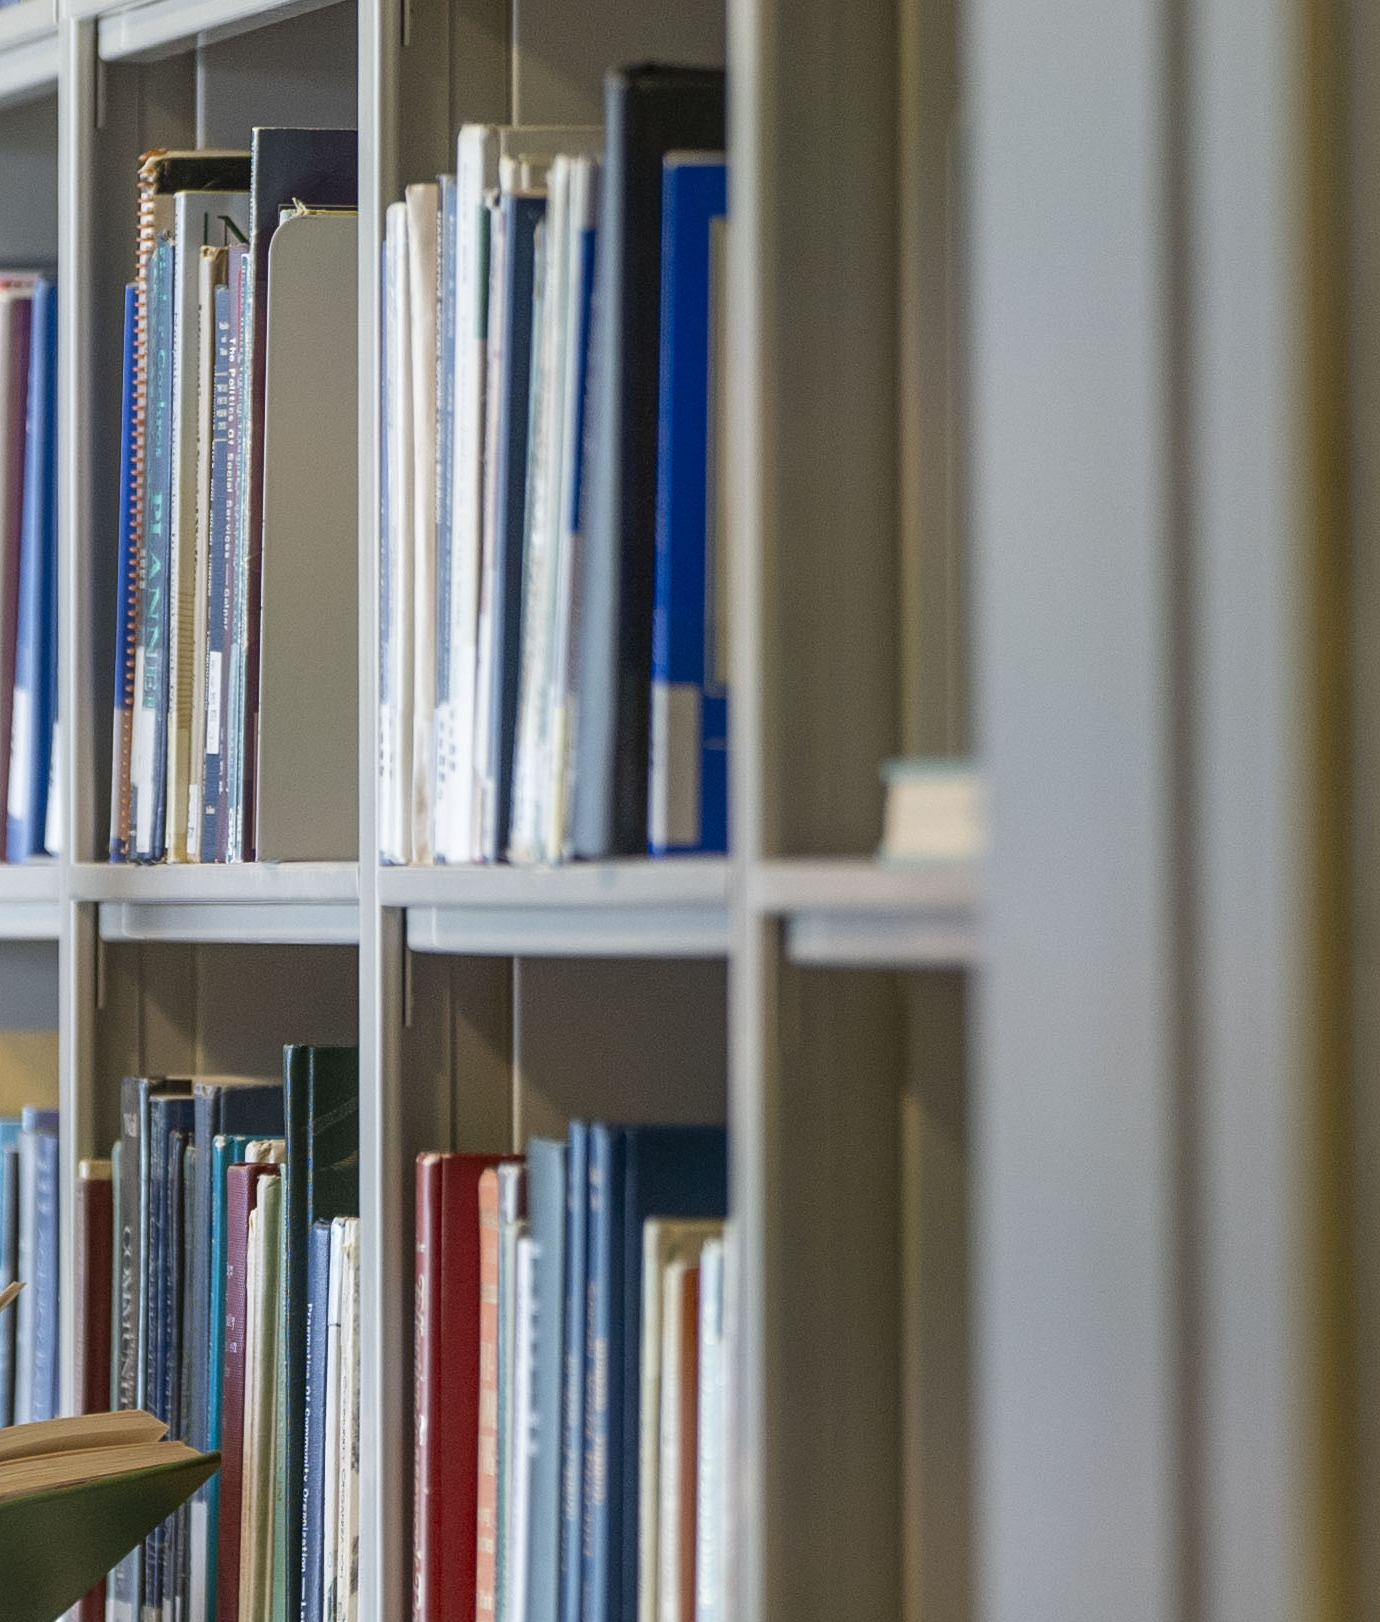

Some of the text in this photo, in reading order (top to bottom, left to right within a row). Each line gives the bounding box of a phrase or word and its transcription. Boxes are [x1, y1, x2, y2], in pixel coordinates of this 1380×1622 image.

[228, 338, 237, 362] The
[227, 368, 236, 422] Politics
[226, 453, 234, 493] Social
[225, 500, 233, 559] Services
[120, 1226, 134, 1409] COMMUNIT
